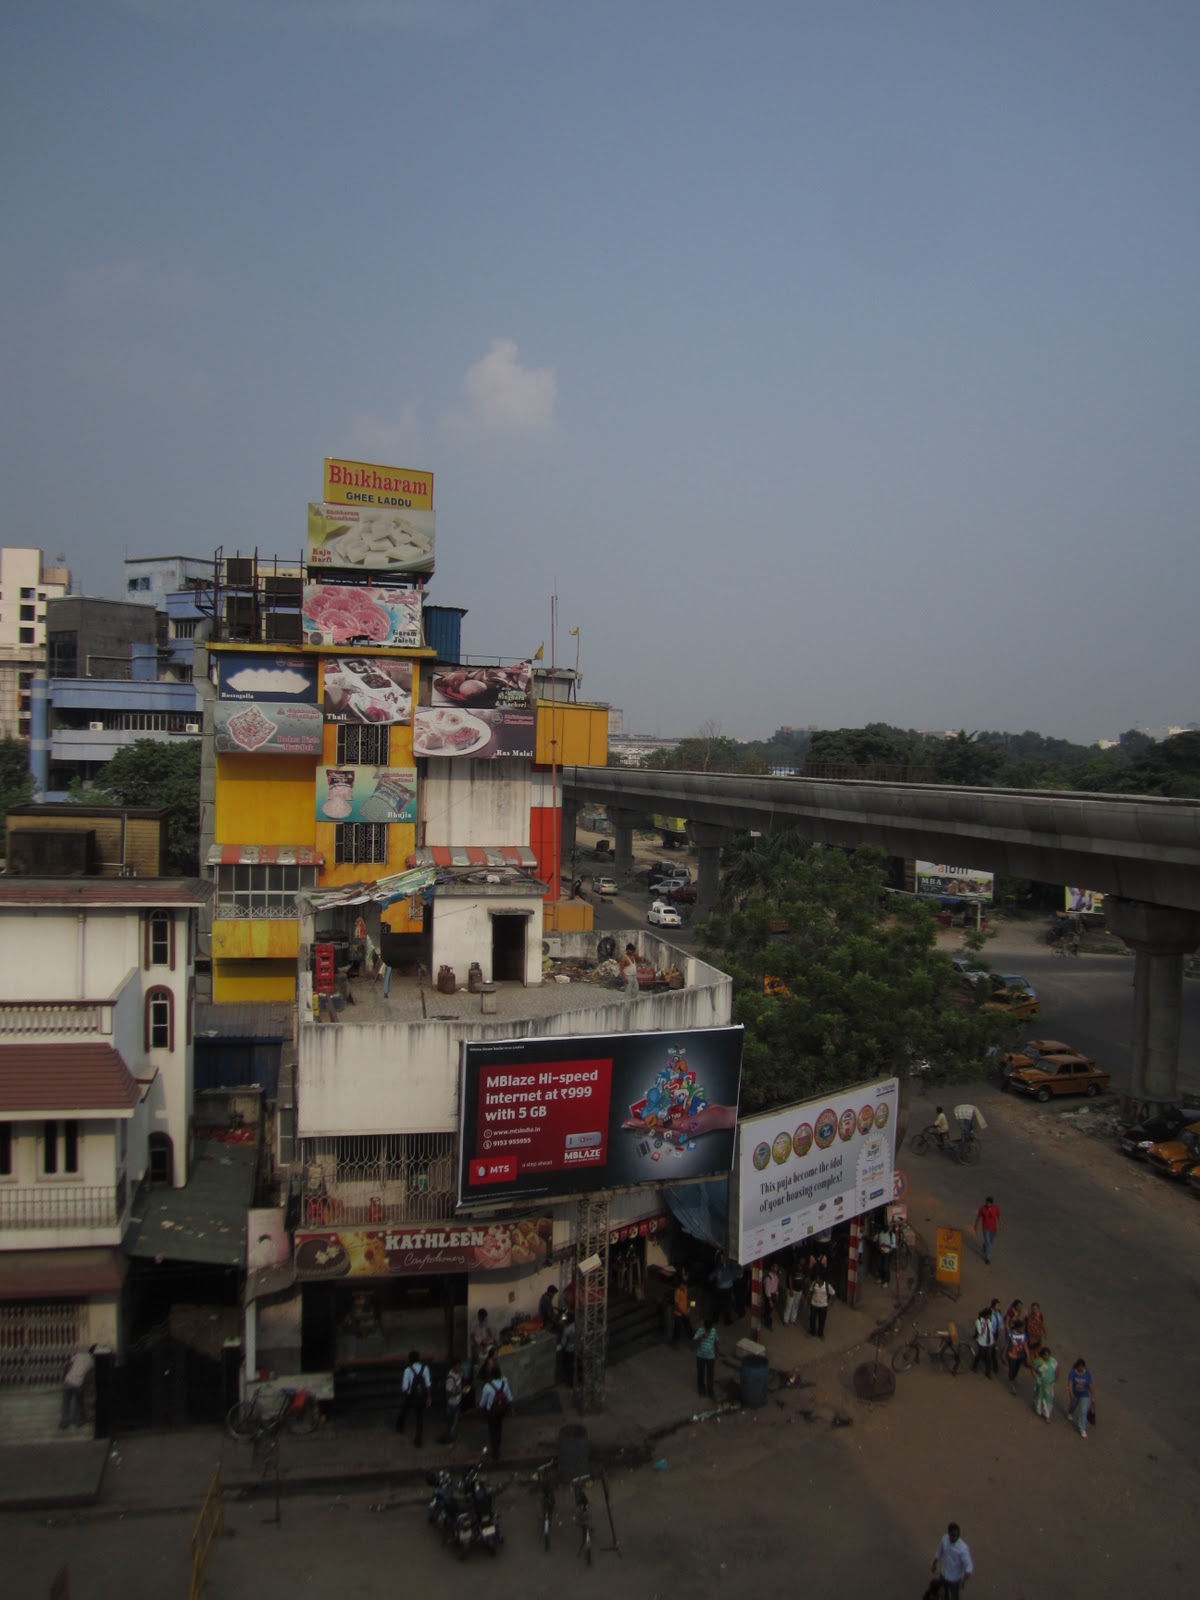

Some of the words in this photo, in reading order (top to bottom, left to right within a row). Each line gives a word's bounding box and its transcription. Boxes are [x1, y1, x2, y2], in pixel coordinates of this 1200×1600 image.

[329, 464, 428, 495] Bhikharam
[346, 491, 374, 503] GHEE
[378, 496, 412, 507] LADDU
[312, 548, 332, 556] Kaju
[392, 629, 417, 637] Garam
[393, 637, 416, 645] Jalebi
[388, 811, 412, 819] Bhujia
[921, 878, 942, 886] MBA
[486, 1075, 535, 1088] MBlaze
[539, 1070, 598, 1084] Hi-speed
[486, 1090, 542, 1104] internet
[545, 1088, 558, 1100] at
[561, 1086, 592, 1100] ₹999
[485, 1108, 515, 1121] with
[519, 1107, 527, 1118] 5
[530, 1106, 547, 1117] GB
[493, 1127, 541, 1136] www.mtsindia.in
[564, 1149, 600, 1160] MBLAZE
[490, 1165, 510, 1174] MTS
[760, 1182, 776, 1195] This
[777, 1176, 792, 1192] puja
[793, 1167, 818, 1182] become
[819, 1162, 829, 1173] the
[830, 1155, 843, 1169] idol
[759, 1199, 769, 1212] of
[767, 1195, 785, 1212] your
[786, 1184, 813, 1198] housing
[814, 1171, 843, 1190] complex!
[385, 1231, 485, 1250] KATHLEEN
[404, 1250, 465, 1269] Confectioners
